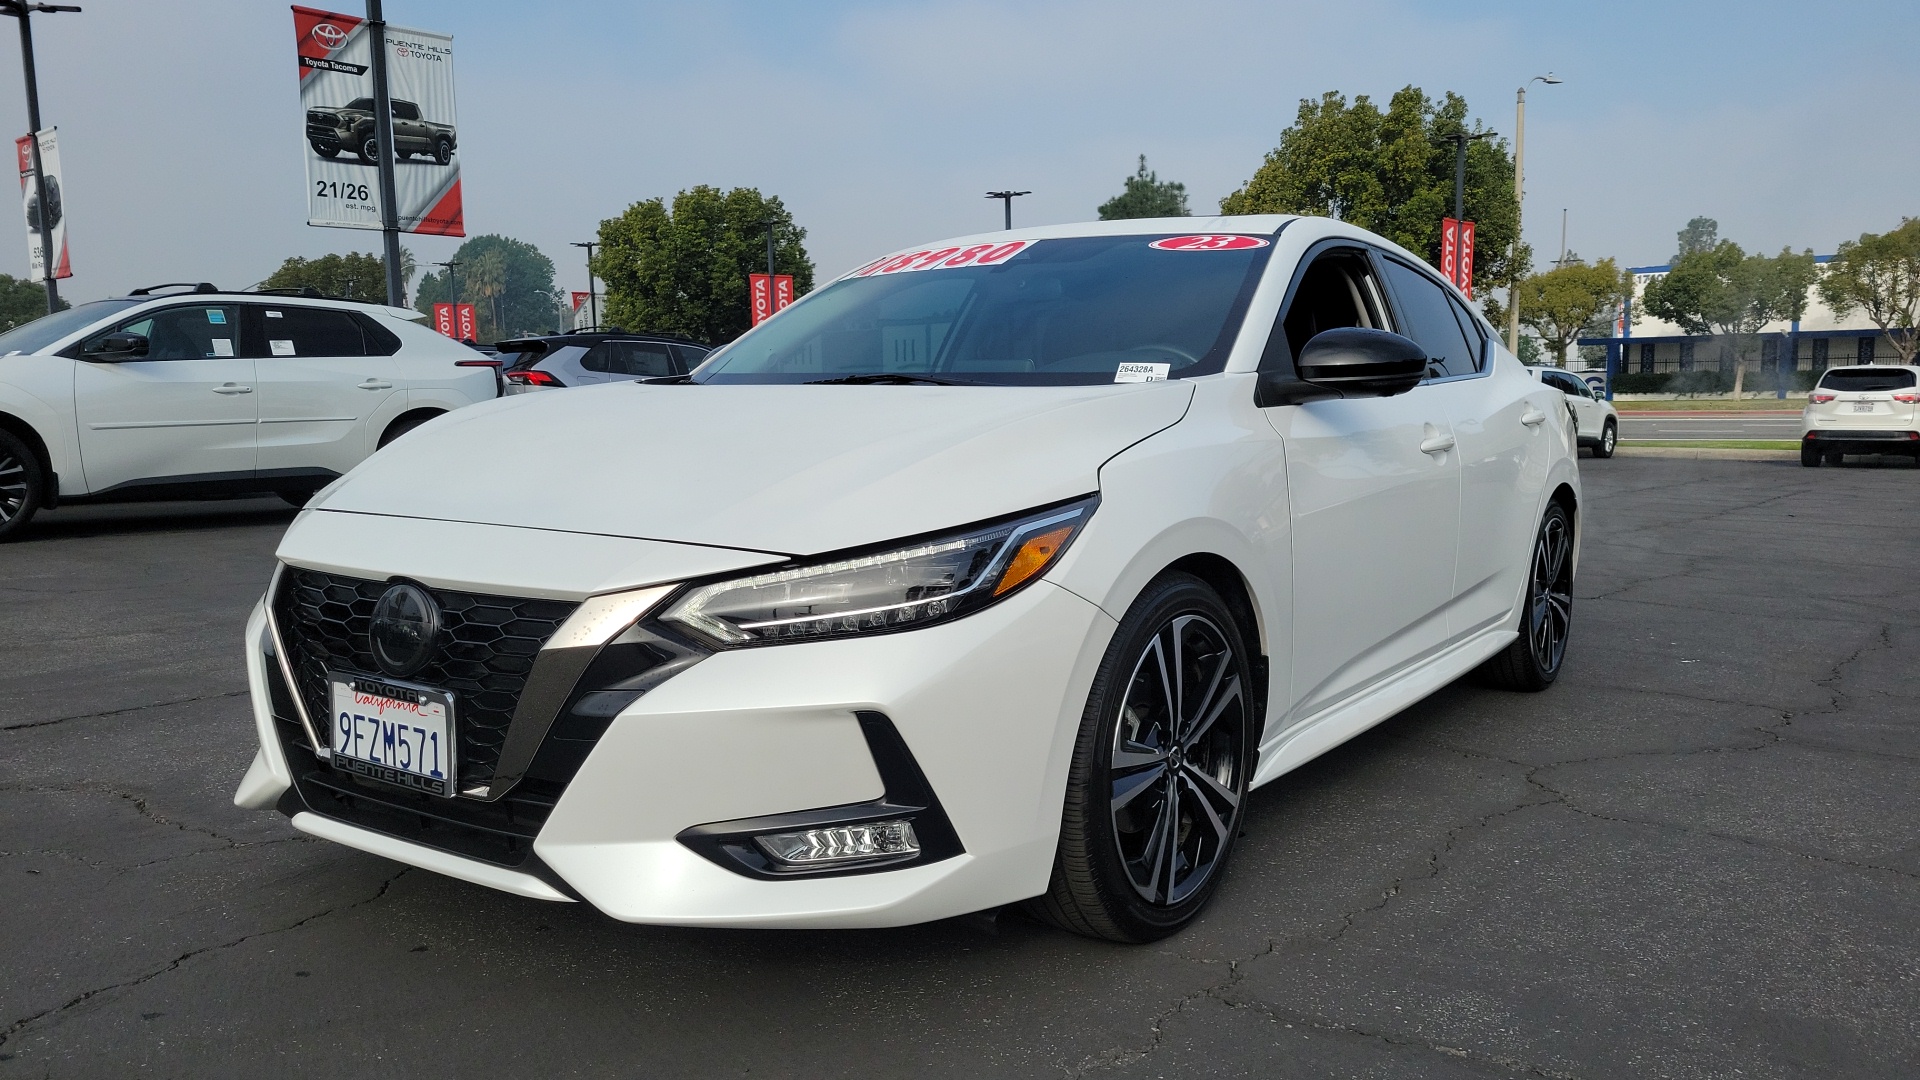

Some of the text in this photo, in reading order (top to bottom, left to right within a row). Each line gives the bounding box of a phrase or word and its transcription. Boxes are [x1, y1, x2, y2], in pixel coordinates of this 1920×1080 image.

[385, 38, 452, 55] PUENTE HILLS
[410, 50, 442, 62] TOYOTA
[304, 57, 358, 73] Toyota Tacoma
[316, 180, 369, 201] 21/26
[360, 204, 376, 213] mpg
[1176, 234, 1237, 249] 23
[778, 280, 788, 310] OTA
[461, 307, 472, 339] YOTA
[356, 679, 418, 702] TOYOTA
[354, 691, 428, 716] California
[339, 711, 444, 779] 9FZM571
[336, 755, 444, 794] PUENTE HILLS
